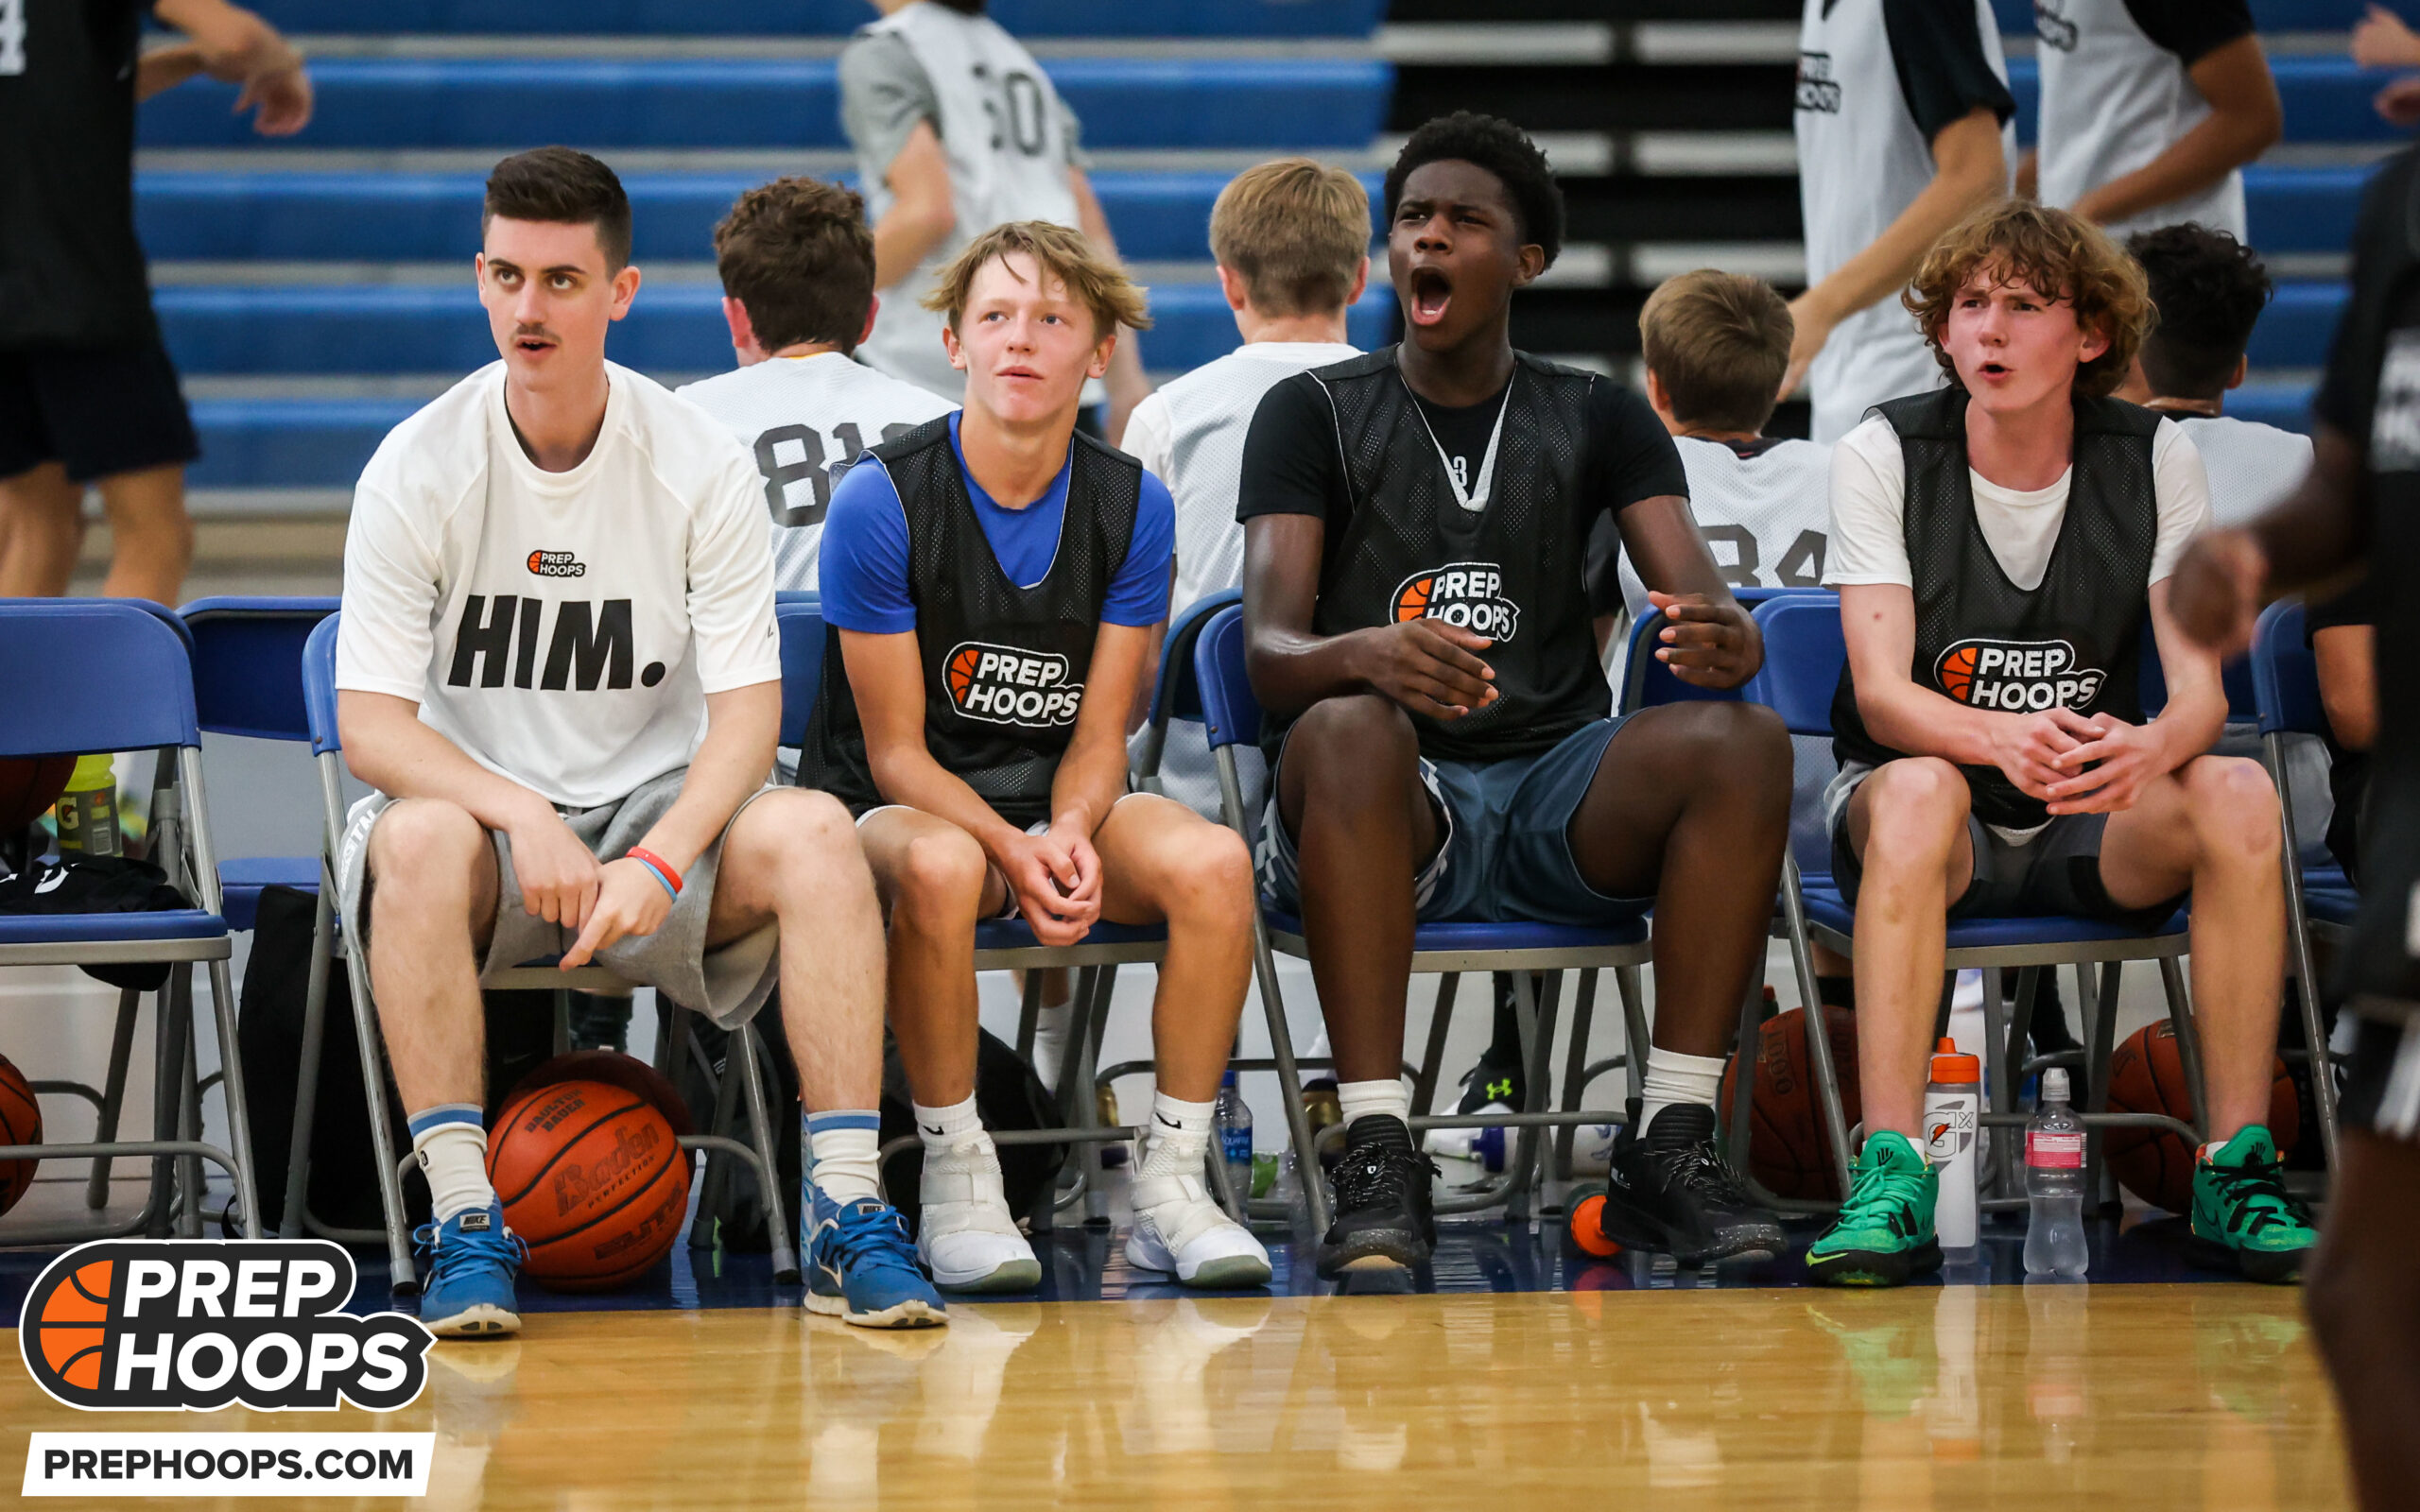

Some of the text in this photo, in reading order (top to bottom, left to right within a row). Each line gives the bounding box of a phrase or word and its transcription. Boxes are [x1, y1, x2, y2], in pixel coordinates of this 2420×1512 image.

[539, 564, 583, 576] HOOPS
[541, 552, 573, 564] PREP
[1430, 571, 1500, 603] PREP
[447, 594, 666, 692] HIM.
[977, 652, 1063, 688] PREP
[1978, 647, 2066, 678] PREP
[964, 683, 1081, 718] HOOPS
[1971, 677, 2099, 710] HOOPS
[554, 1123, 661, 1217] Baden
[463, 1214, 487, 1226] NIKE
